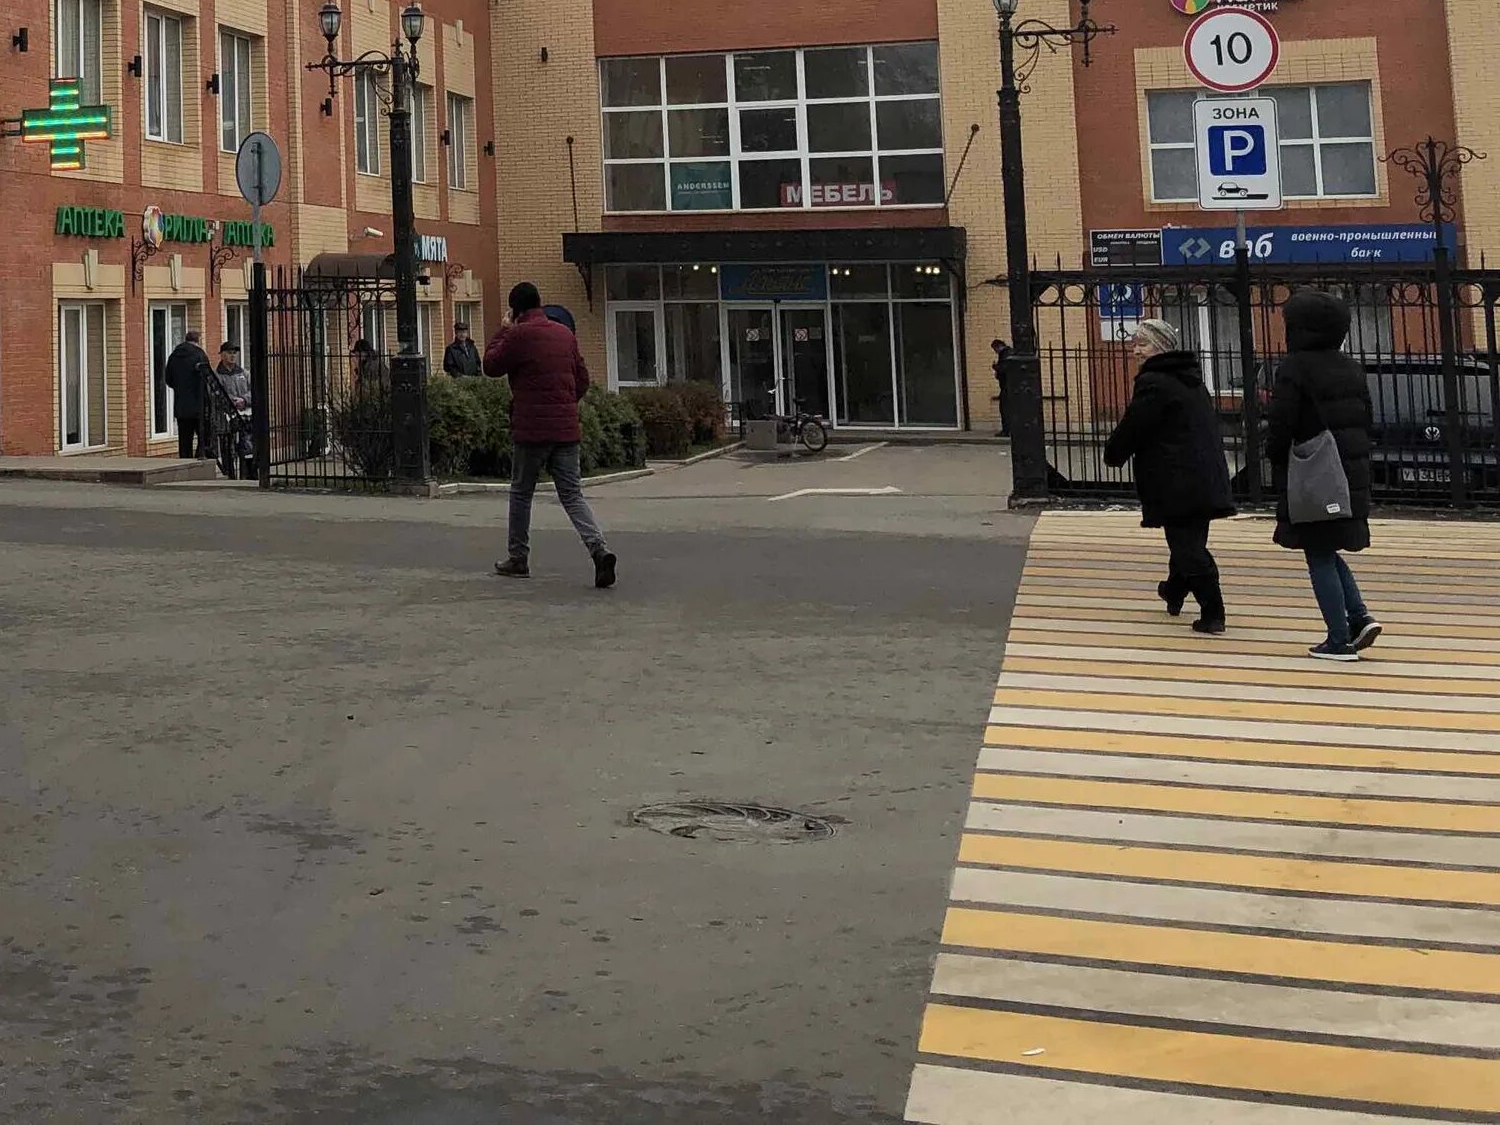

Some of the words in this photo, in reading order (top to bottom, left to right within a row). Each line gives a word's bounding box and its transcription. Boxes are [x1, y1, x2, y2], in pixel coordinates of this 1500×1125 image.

[1210, 32, 1252, 65] 10
[1212, 107, 1260, 120] ЗОНА
[1223, 130, 1255, 171] P
[786, 184, 893, 205] МЕБЕЛЬ
[57, 206, 125, 237] АПТЕКА
[223, 220, 276, 246] АПТКА
[421, 235, 448, 262] МЯТА
[1351, 247, 1381, 258] банк
